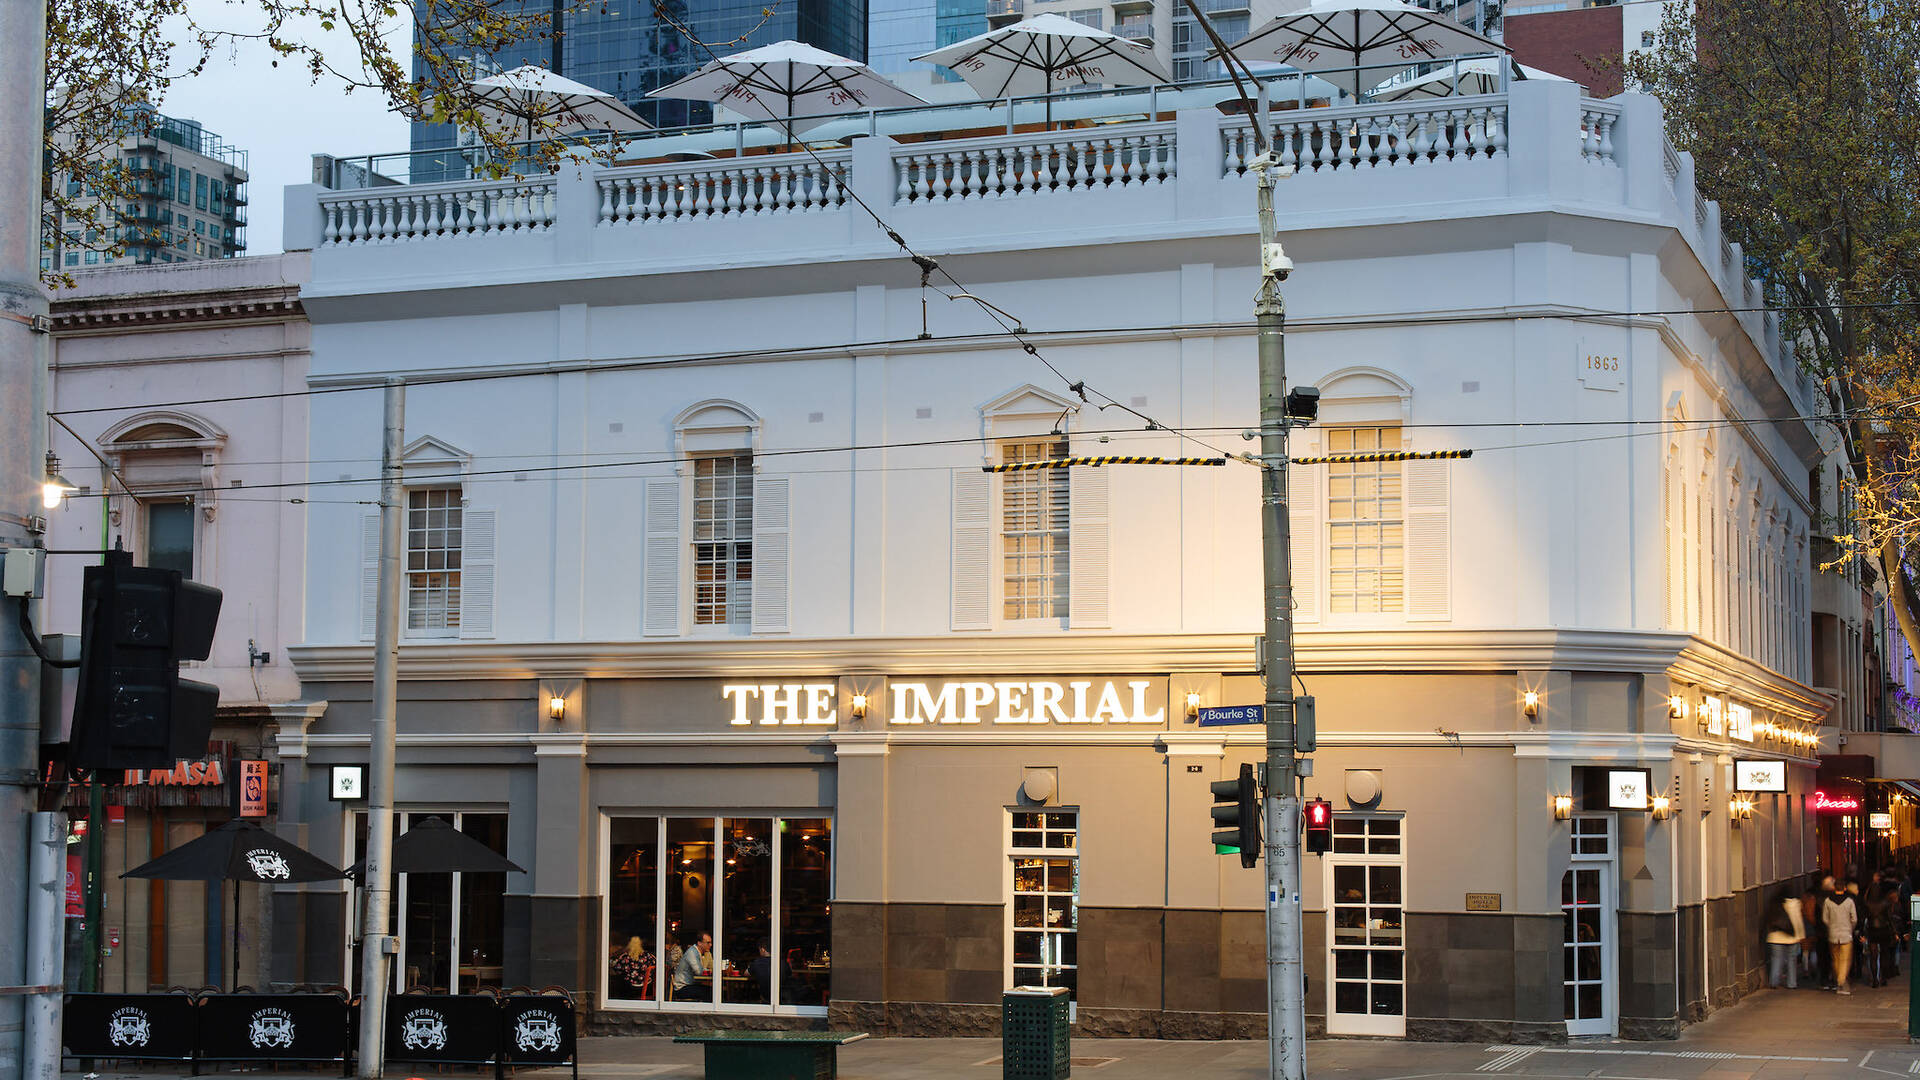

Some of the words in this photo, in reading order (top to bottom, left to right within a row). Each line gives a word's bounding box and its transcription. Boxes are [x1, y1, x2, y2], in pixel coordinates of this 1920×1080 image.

[1587, 355, 1618, 371] 1863
[723, 684, 837, 725] THE
[890, 680, 1165, 725] IMPERIAL
[1208, 709, 1244, 720] Bourke
[1246, 708, 1258, 718] St
[245, 848, 280, 859] IMPERIAL
[1273, 846, 1286, 857] 65
[111, 1007, 147, 1019] IMPERIAL
[251, 1007, 292, 1020] IMPERIAL
[404, 1008, 444, 1021] IMPERIAL
[517, 1009, 558, 1022] IMPERIAL
